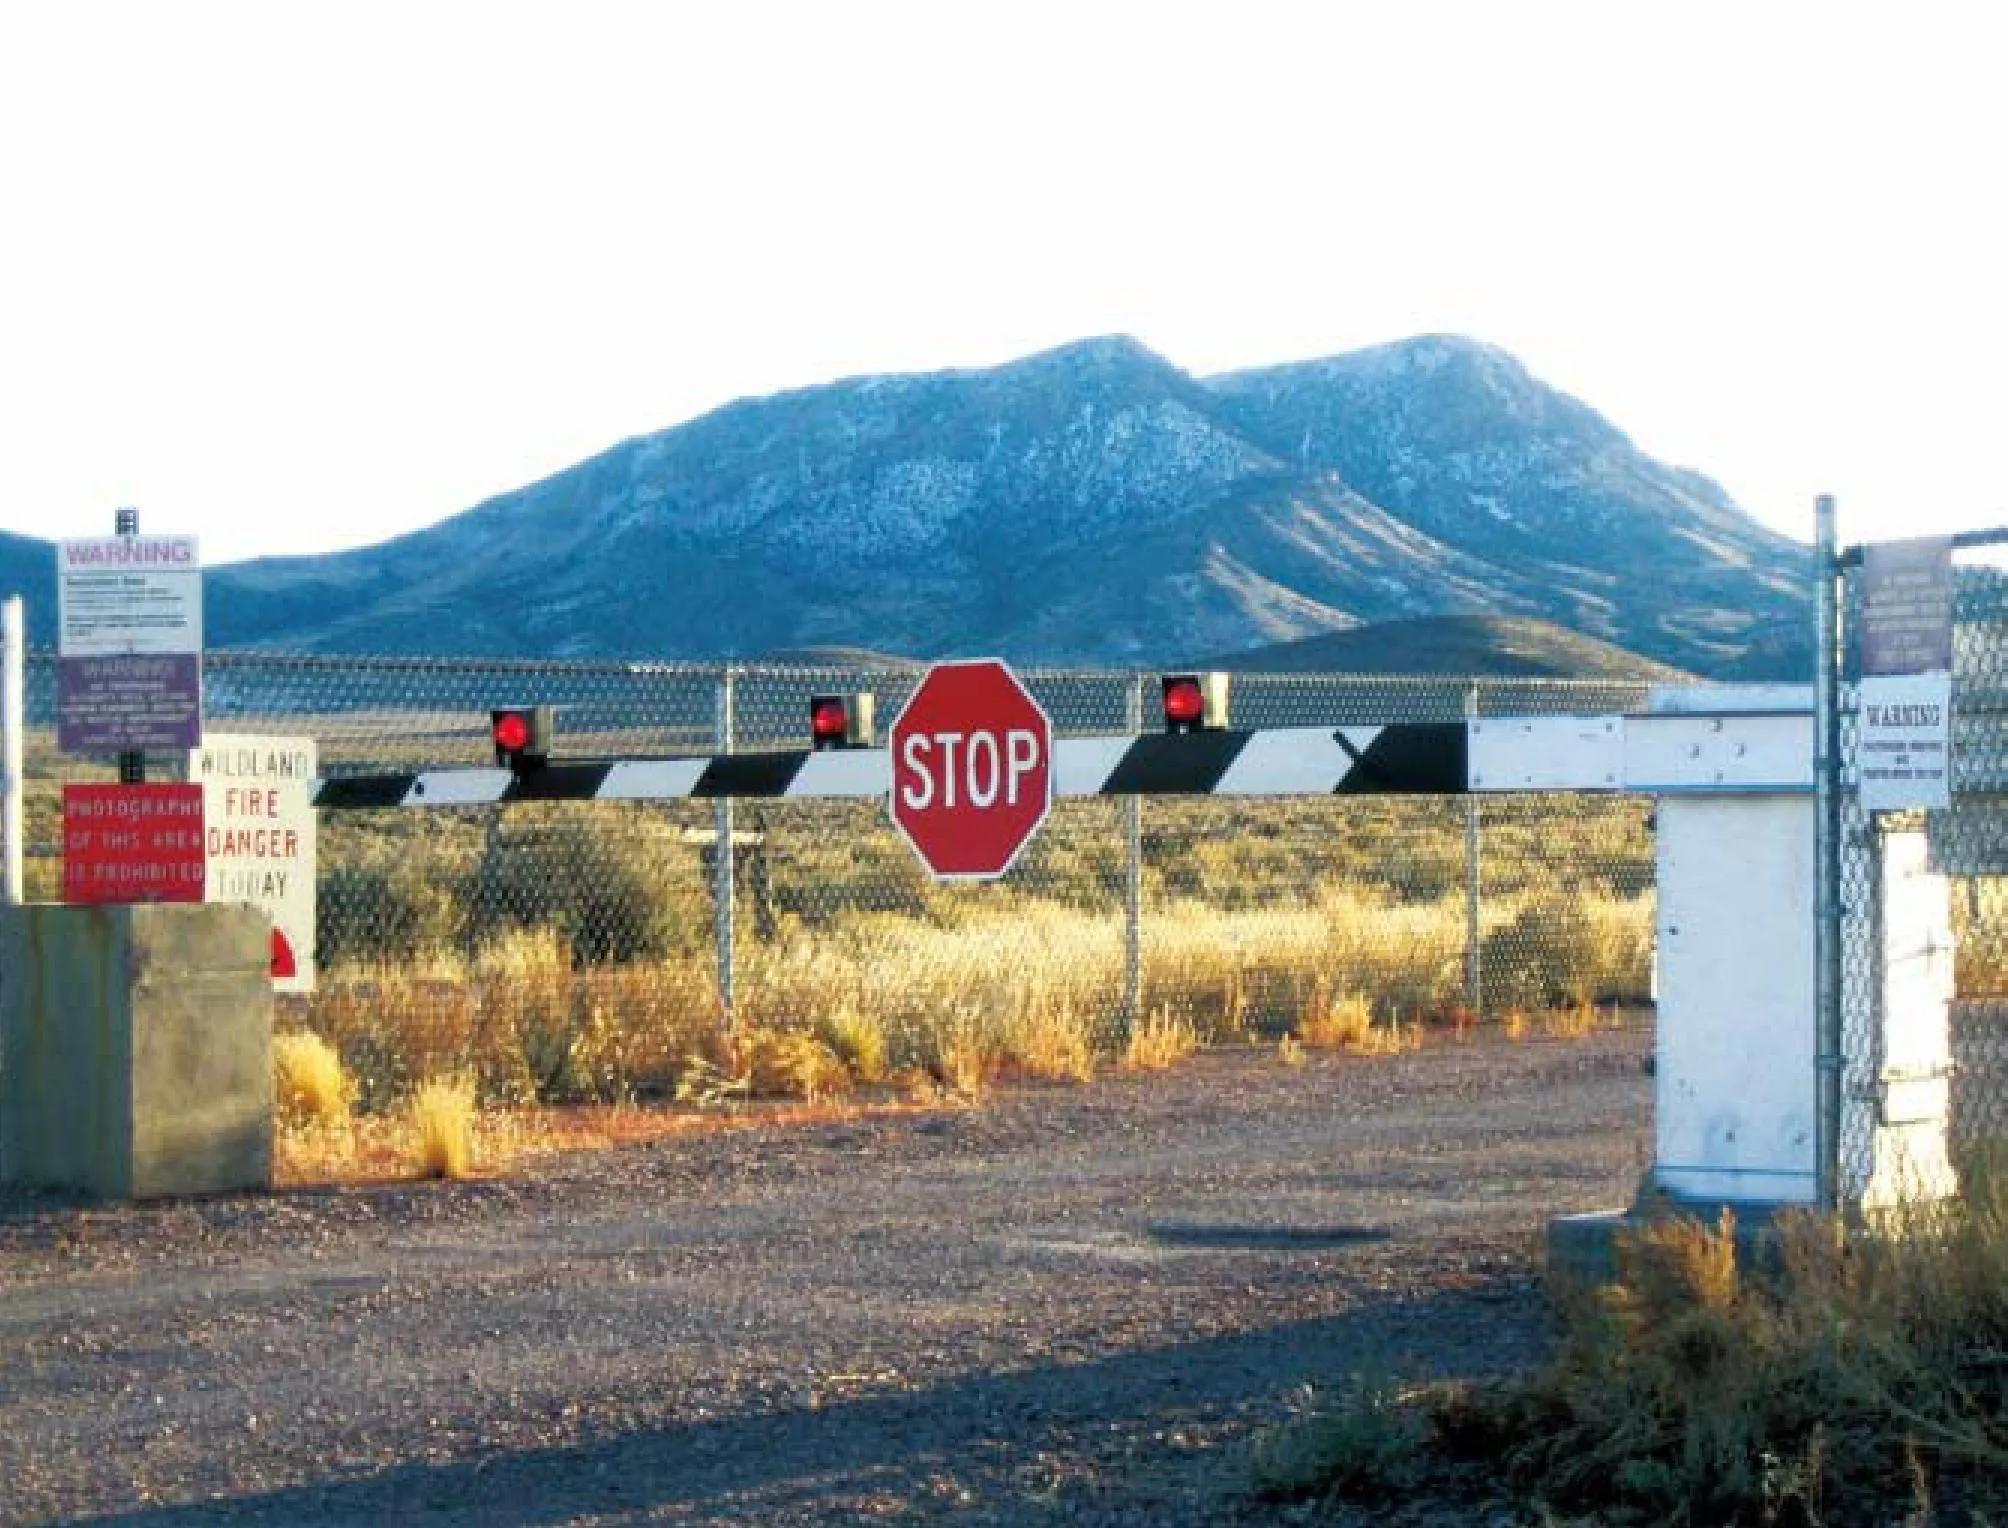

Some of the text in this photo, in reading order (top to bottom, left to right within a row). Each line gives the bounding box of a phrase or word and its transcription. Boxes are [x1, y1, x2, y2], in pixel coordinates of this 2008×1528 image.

[66, 541, 191, 564] WARNING
[201, 749, 309, 777] WILDLAND
[904, 731, 1038, 808] STOP
[226, 788, 280, 818] FIRE
[102, 830, 140, 848] THIS
[153, 829, 201, 848] AREA
[208, 827, 297, 858] DANGER
[93, 863, 202, 881] PROHIBITED
[218, 871, 287, 897] TODAY
